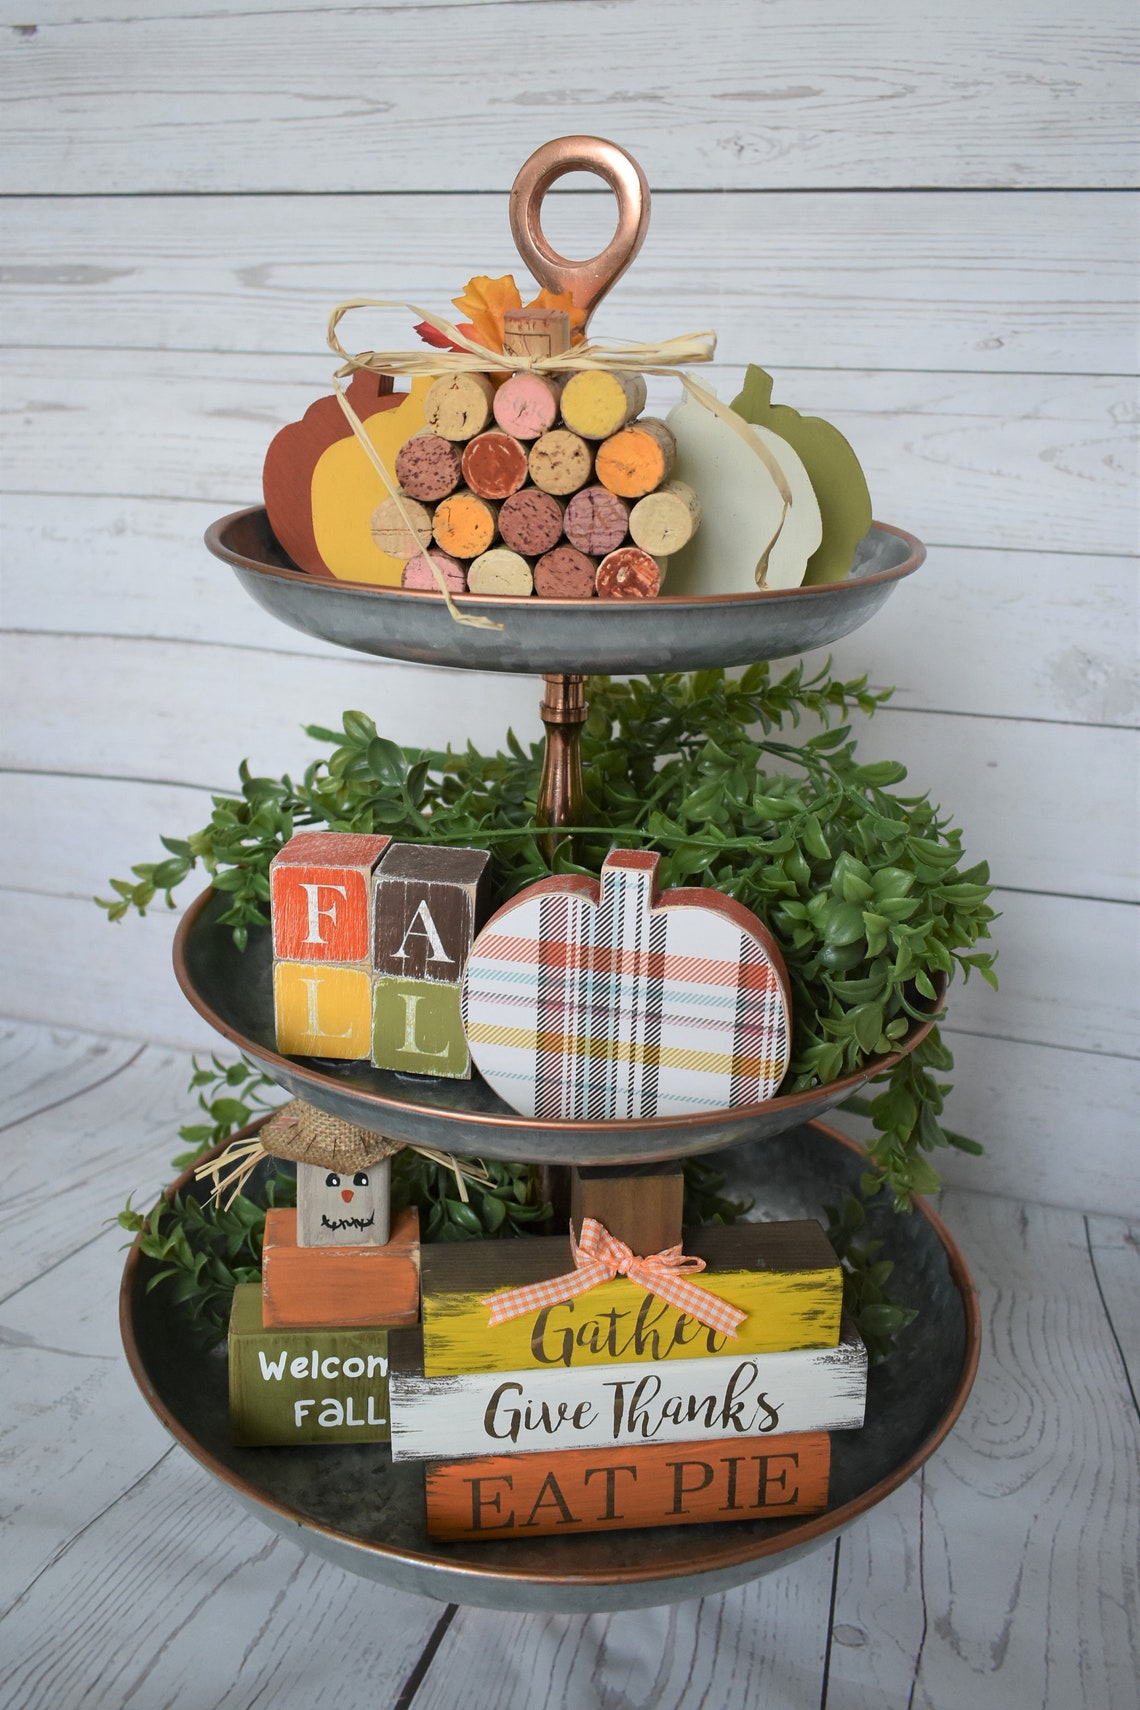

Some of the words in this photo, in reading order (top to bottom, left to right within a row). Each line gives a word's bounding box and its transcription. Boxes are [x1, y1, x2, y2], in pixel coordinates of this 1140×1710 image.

[258, 1349, 389, 1381] Welcom
[531, 1293, 728, 1368] Gather
[483, 1381, 599, 1444] Give
[602, 1360, 784, 1439] Thanks
[462, 1464, 638, 1533] EAT
[664, 1452, 800, 1517] PIE
